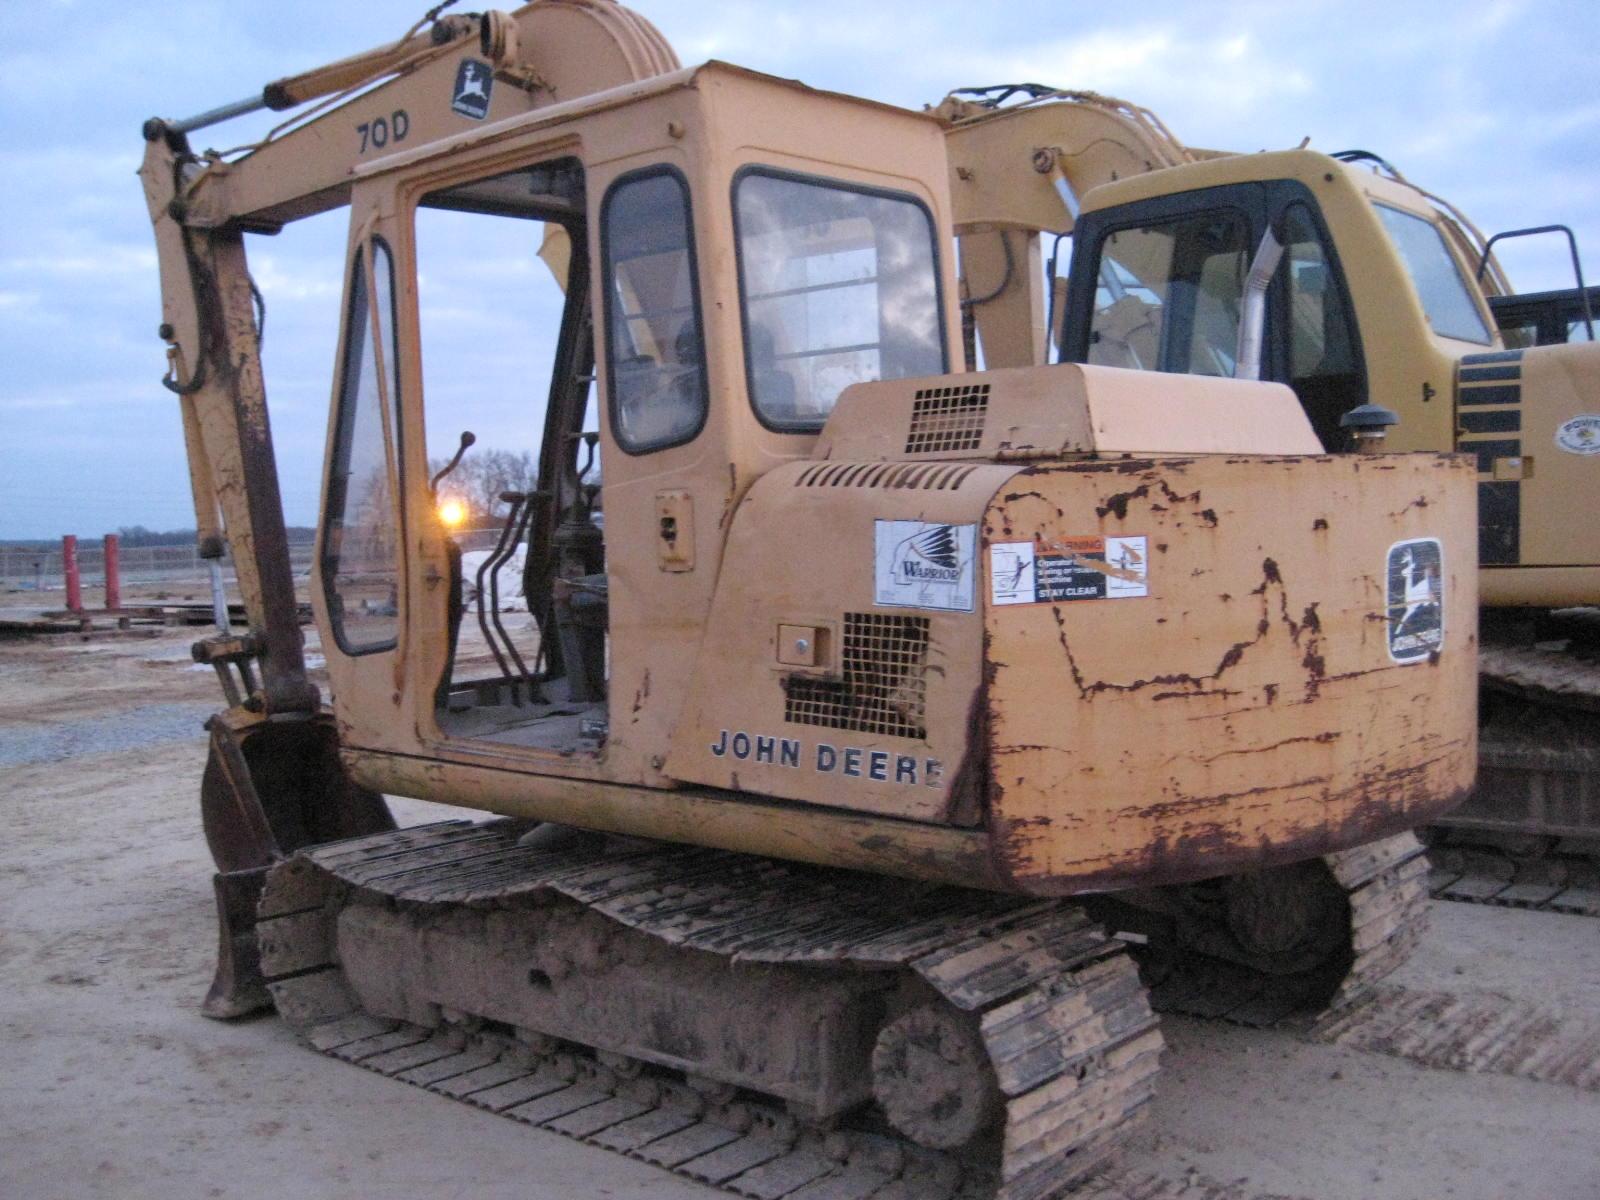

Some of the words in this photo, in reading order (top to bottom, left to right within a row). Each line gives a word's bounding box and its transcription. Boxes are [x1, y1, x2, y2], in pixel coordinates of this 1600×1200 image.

[356, 108, 409, 154] 70D
[1038, 588, 1065, 598] STAY
[1065, 586, 1098, 596] CLEAR
[711, 730, 801, 769] JOHN
[815, 742, 945, 790] DEERE
